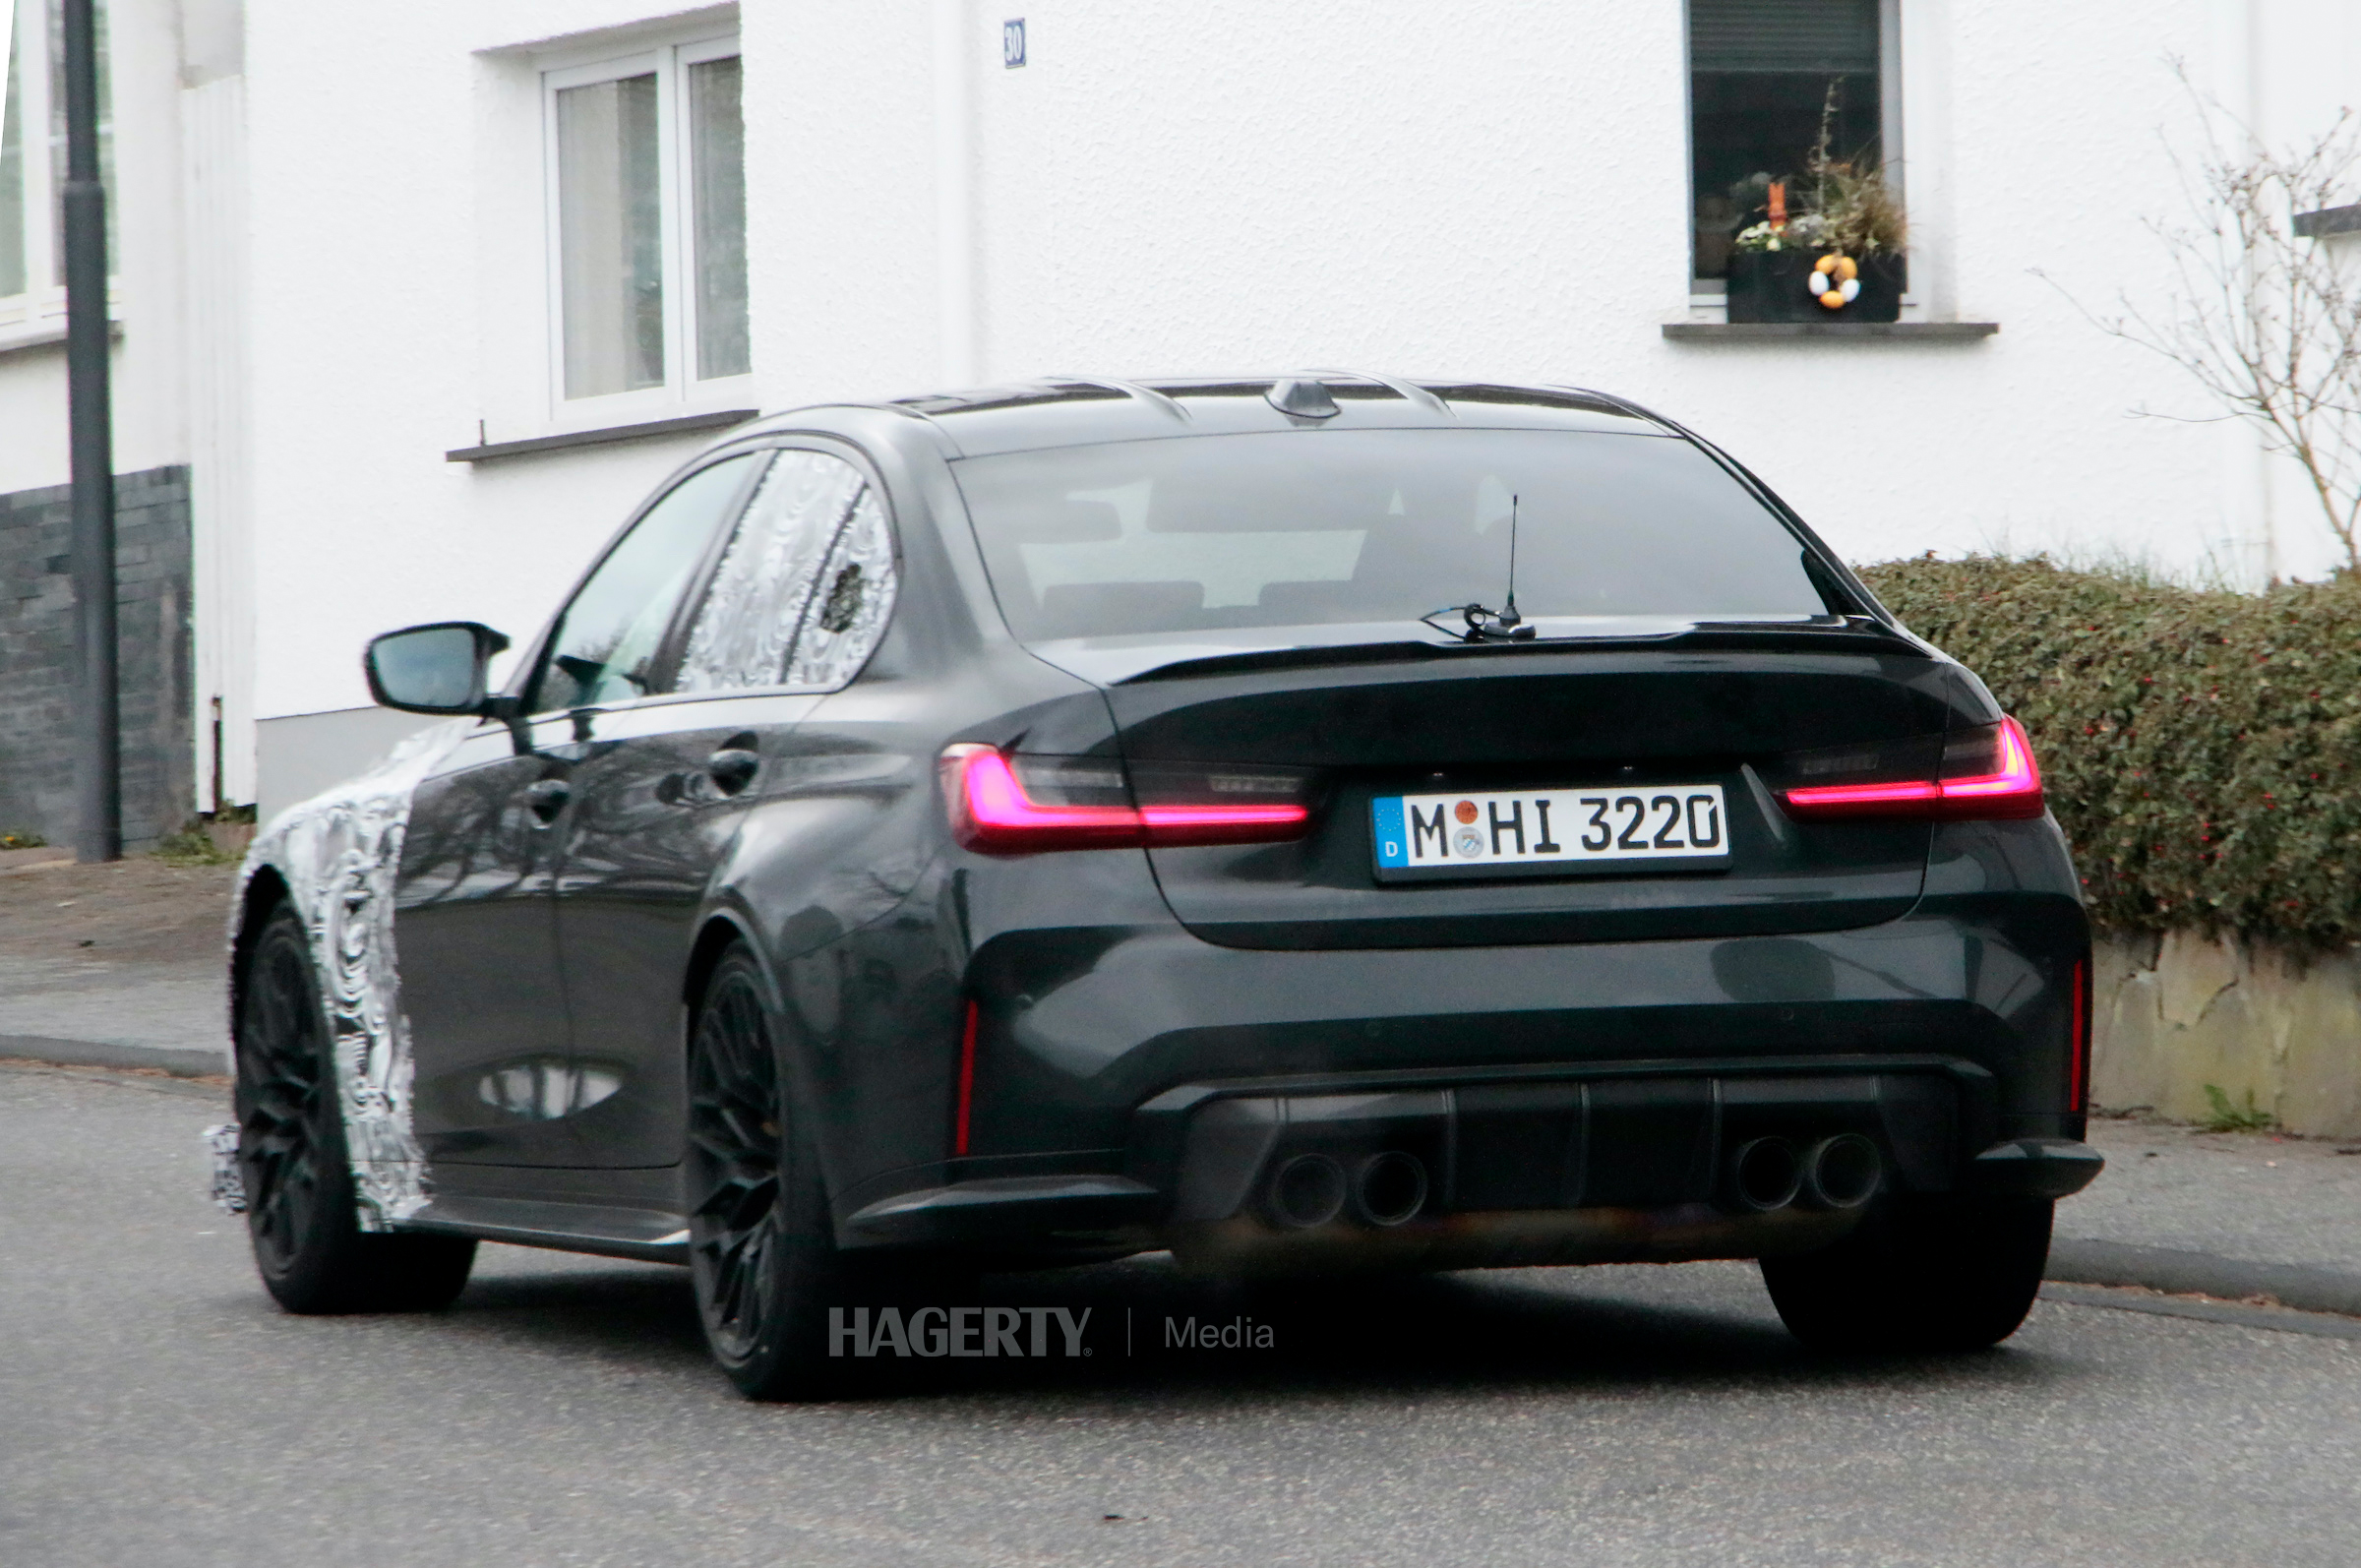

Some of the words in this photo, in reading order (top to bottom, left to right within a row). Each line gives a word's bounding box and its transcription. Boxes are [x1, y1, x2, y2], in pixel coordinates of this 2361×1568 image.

[1004, 25, 1022, 61] 30
[1385, 841, 1399, 857] D
[1411, 804, 1449, 858] M
[1487, 800, 1561, 855] HI
[1580, 794, 1721, 853] 3220
